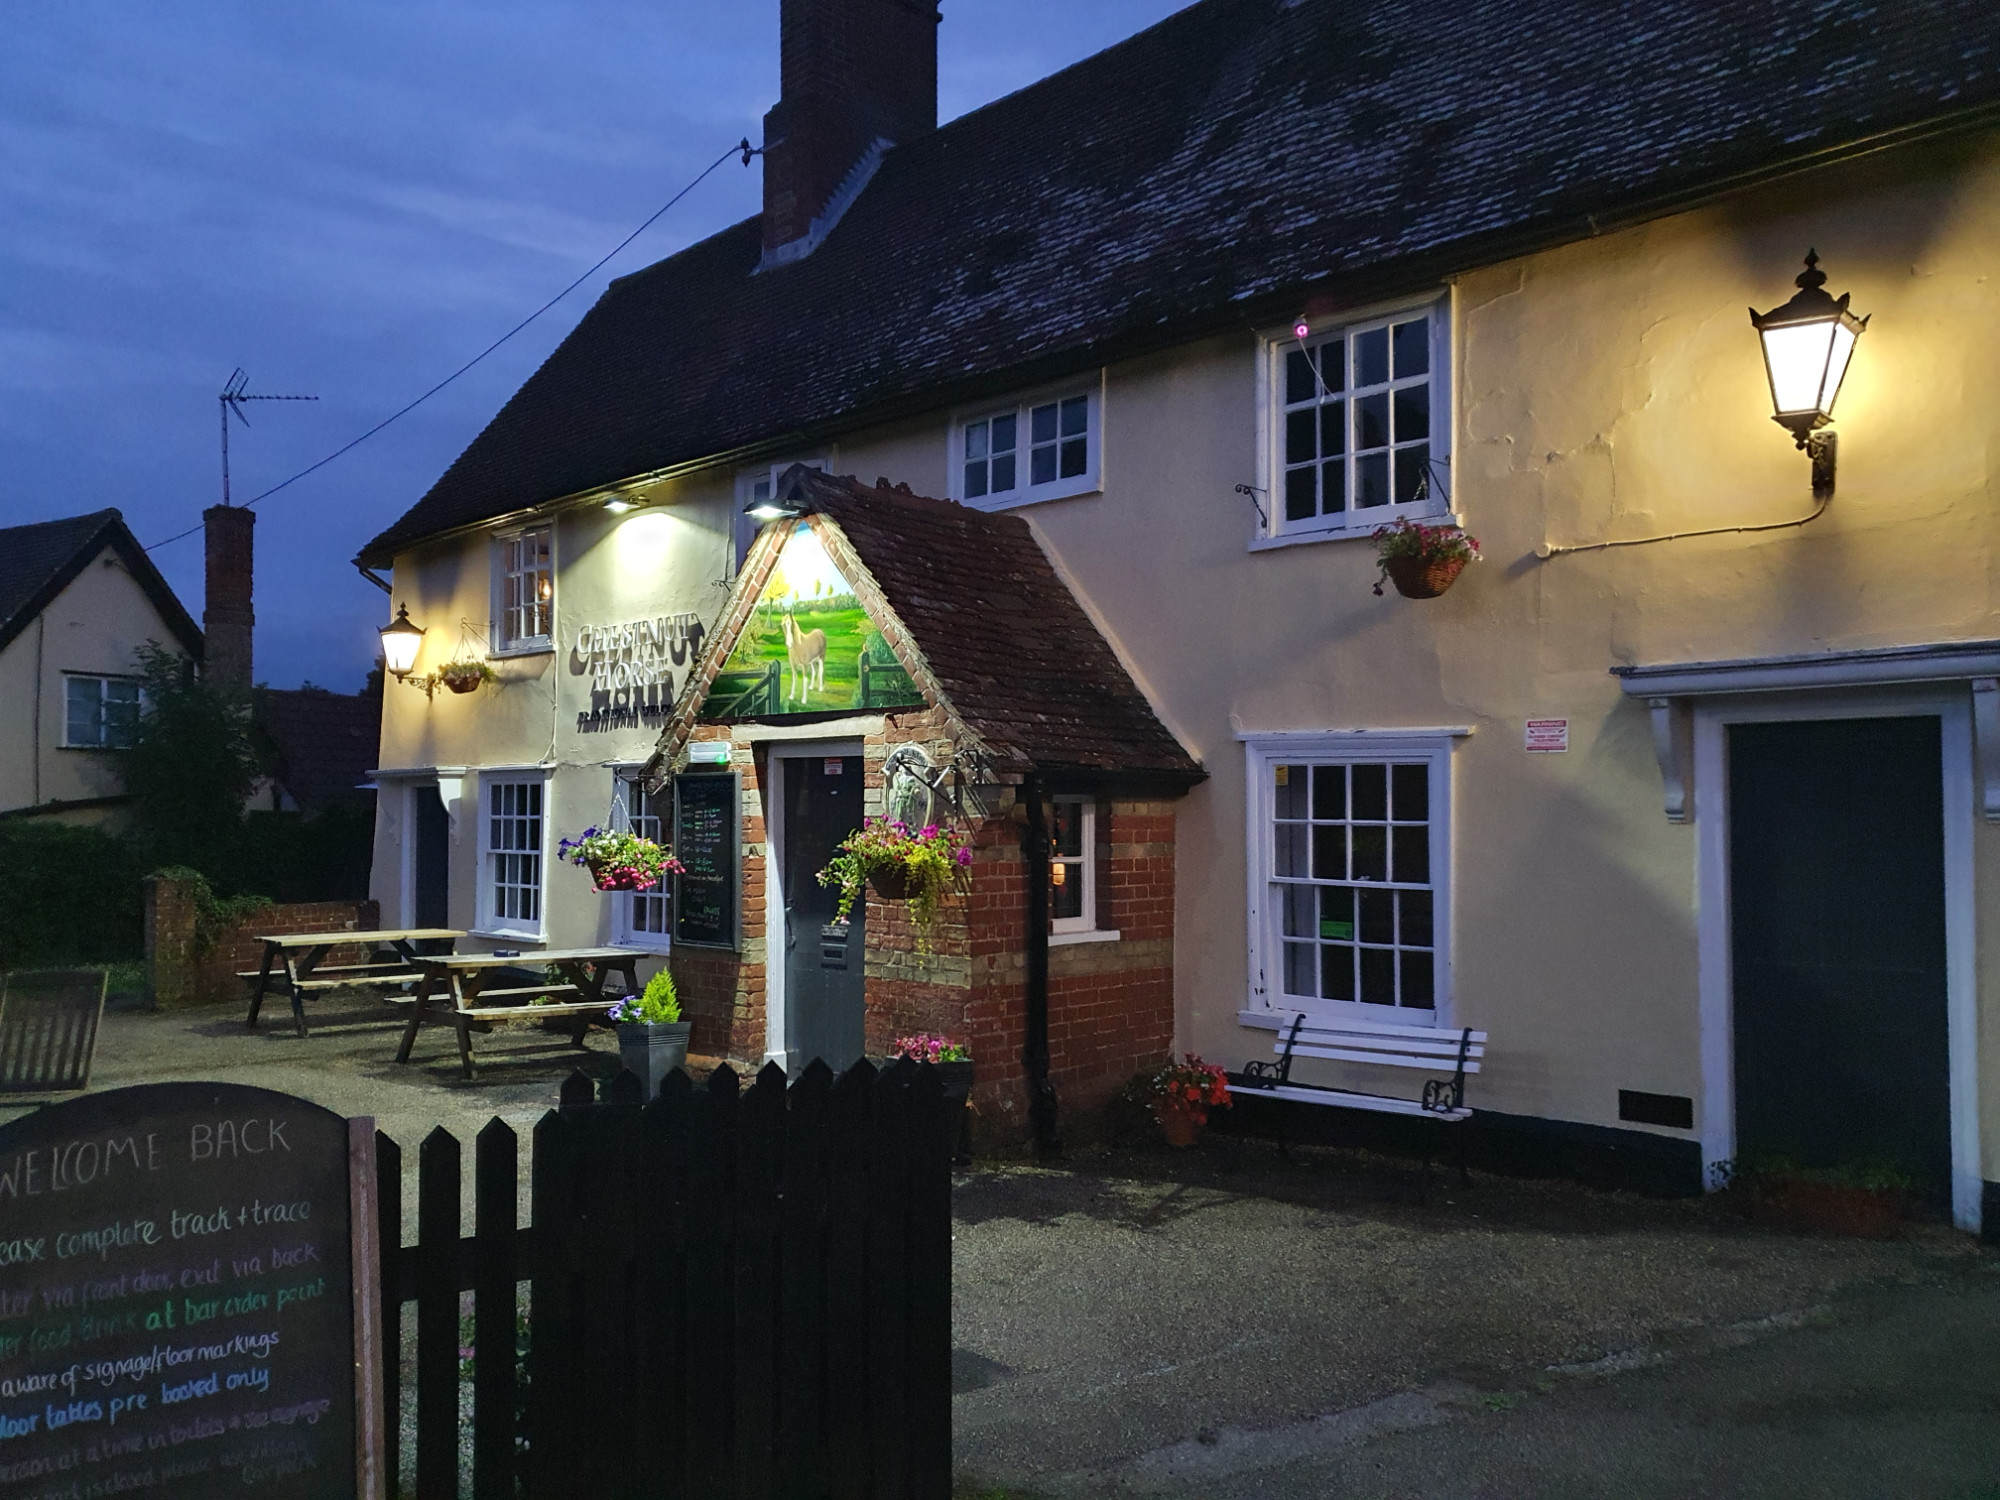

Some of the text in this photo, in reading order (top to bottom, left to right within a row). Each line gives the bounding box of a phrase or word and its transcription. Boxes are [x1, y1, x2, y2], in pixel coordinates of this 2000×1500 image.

[576, 613, 695, 654] CHESTNUT
[594, 658, 667, 691] HORSE
[0, 1118, 292, 1197] WELCOME BACK
[0, 1238, 46, 1266] ease
[56, 1220, 163, 1262] complete
[170, 1205, 232, 1240] track
[250, 1200, 311, 1226] trace
[180, 1258, 220, 1288] exit
[233, 1257, 263, 1278] via
[272, 1243, 320, 1270] back
[145, 1300, 176, 1330] at
[185, 1298, 220, 1326] bar
[223, 1292, 269, 1317] order
[276, 1278, 325, 1312] point
[2, 1373, 57, 1398] aware
[60, 1364, 82, 1398] of
[197, 1331, 280, 1359] markings
[45, 1400, 103, 1431] tables
[110, 1393, 148, 1426] pre
[161, 1372, 219, 1404] booked
[226, 1366, 270, 1393] only
